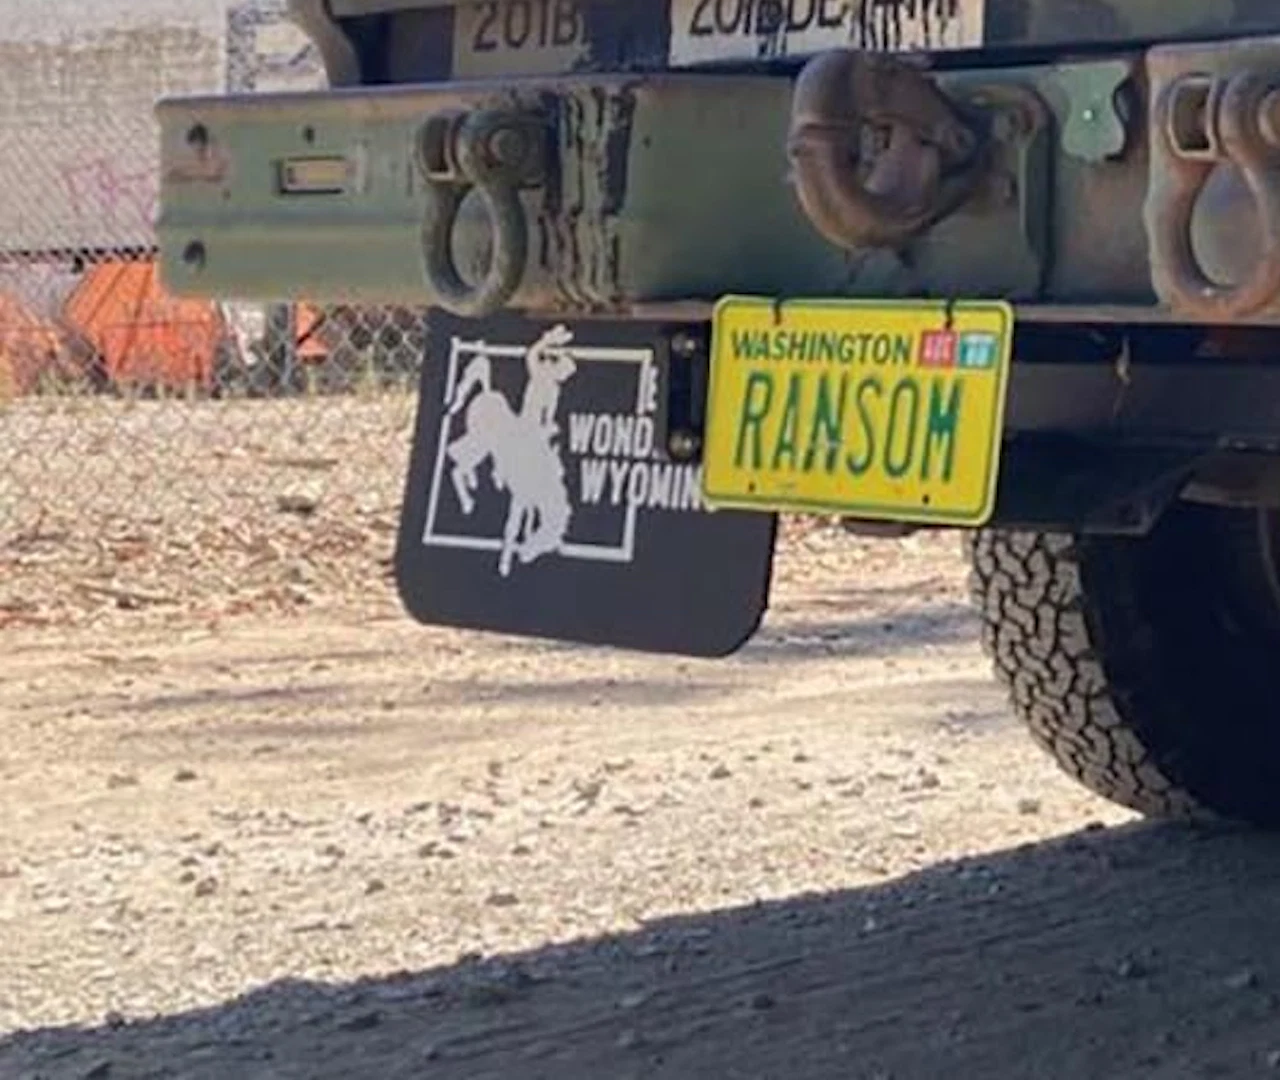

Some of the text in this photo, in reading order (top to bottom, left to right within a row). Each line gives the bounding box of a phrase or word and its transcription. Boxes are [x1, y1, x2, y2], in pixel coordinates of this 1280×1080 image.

[731, 328, 913, 365] WASHINGTON
[733, 371, 963, 484] RANSOM
[580, 459, 704, 511] WYOMIN
